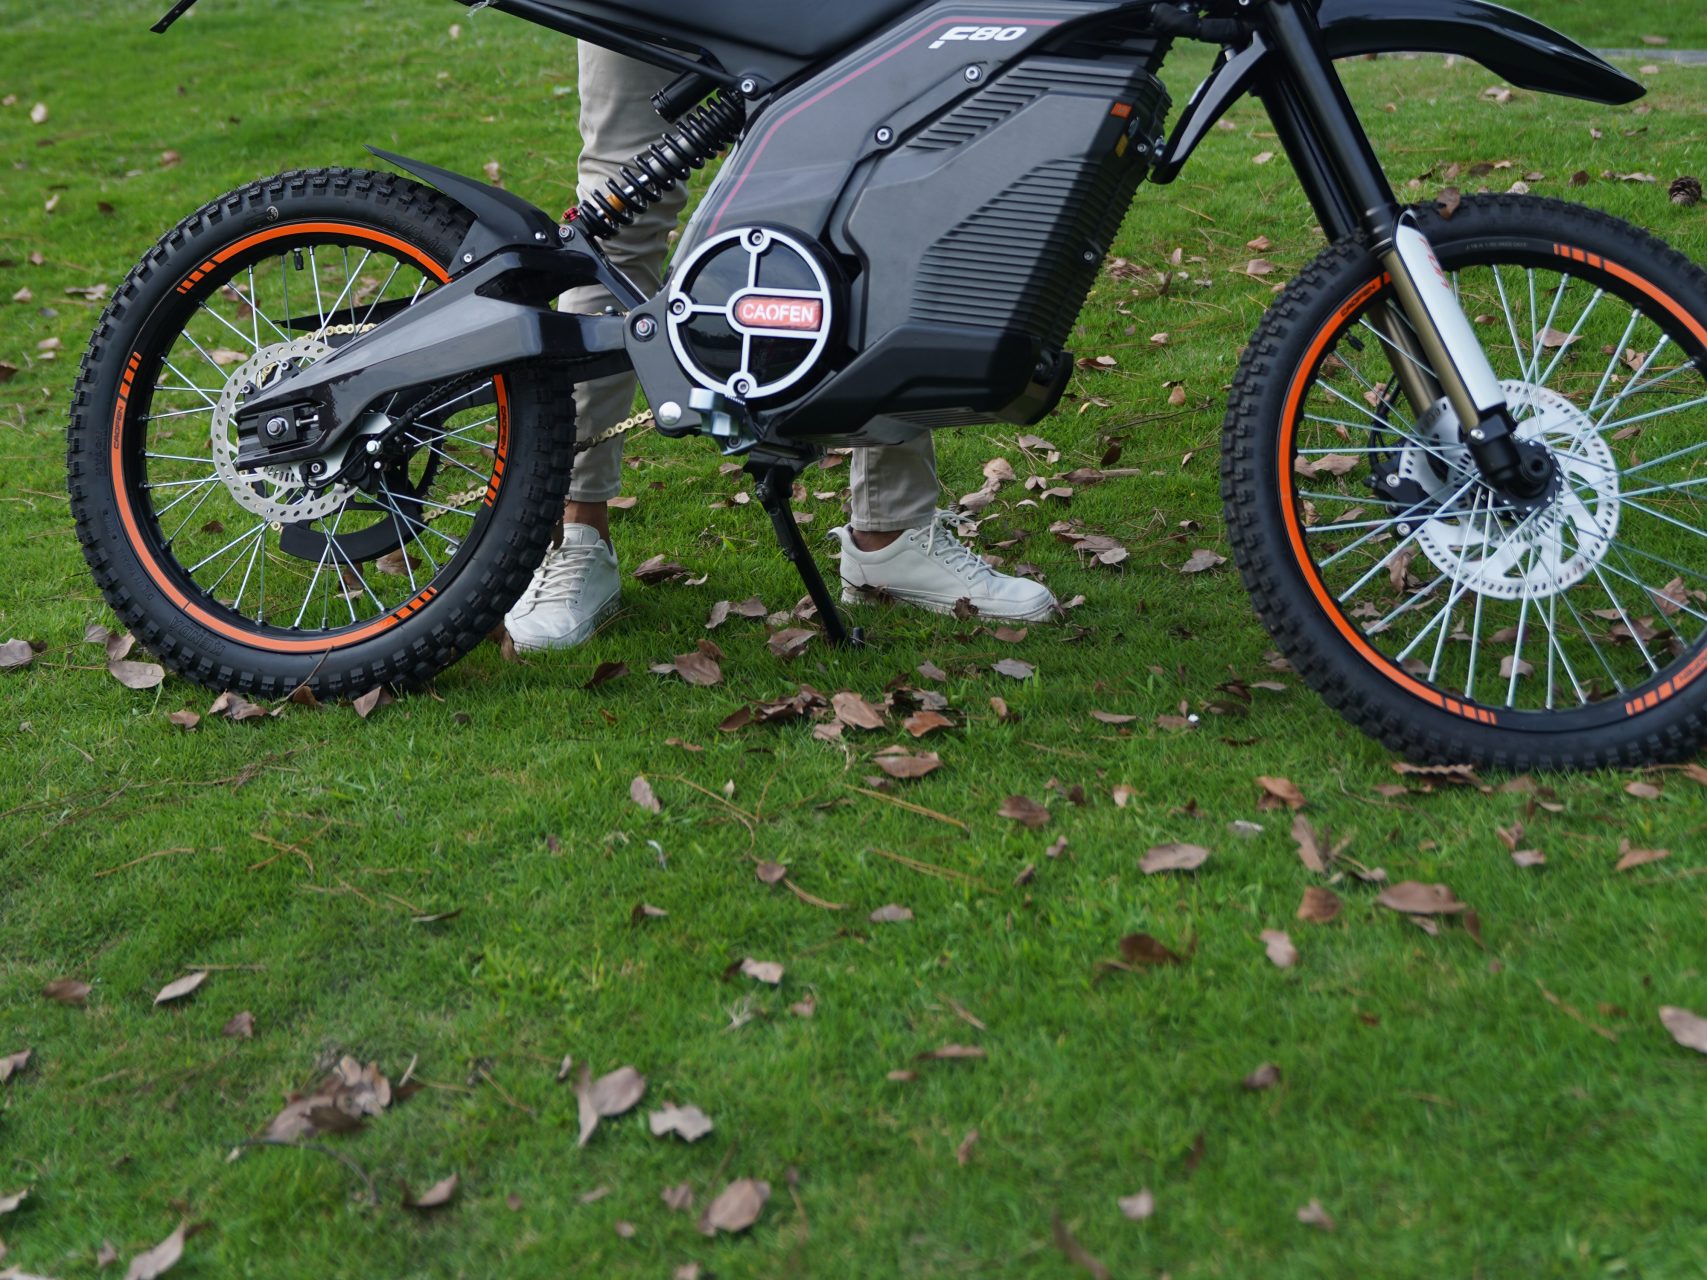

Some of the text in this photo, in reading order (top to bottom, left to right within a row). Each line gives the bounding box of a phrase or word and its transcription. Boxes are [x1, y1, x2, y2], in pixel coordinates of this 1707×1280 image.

[928, 26, 1027, 49] F80
[742, 303, 814, 323] CAOFEN
[114, 404, 124, 449] CAOFEN
[169, 616, 225, 656] KENDA
